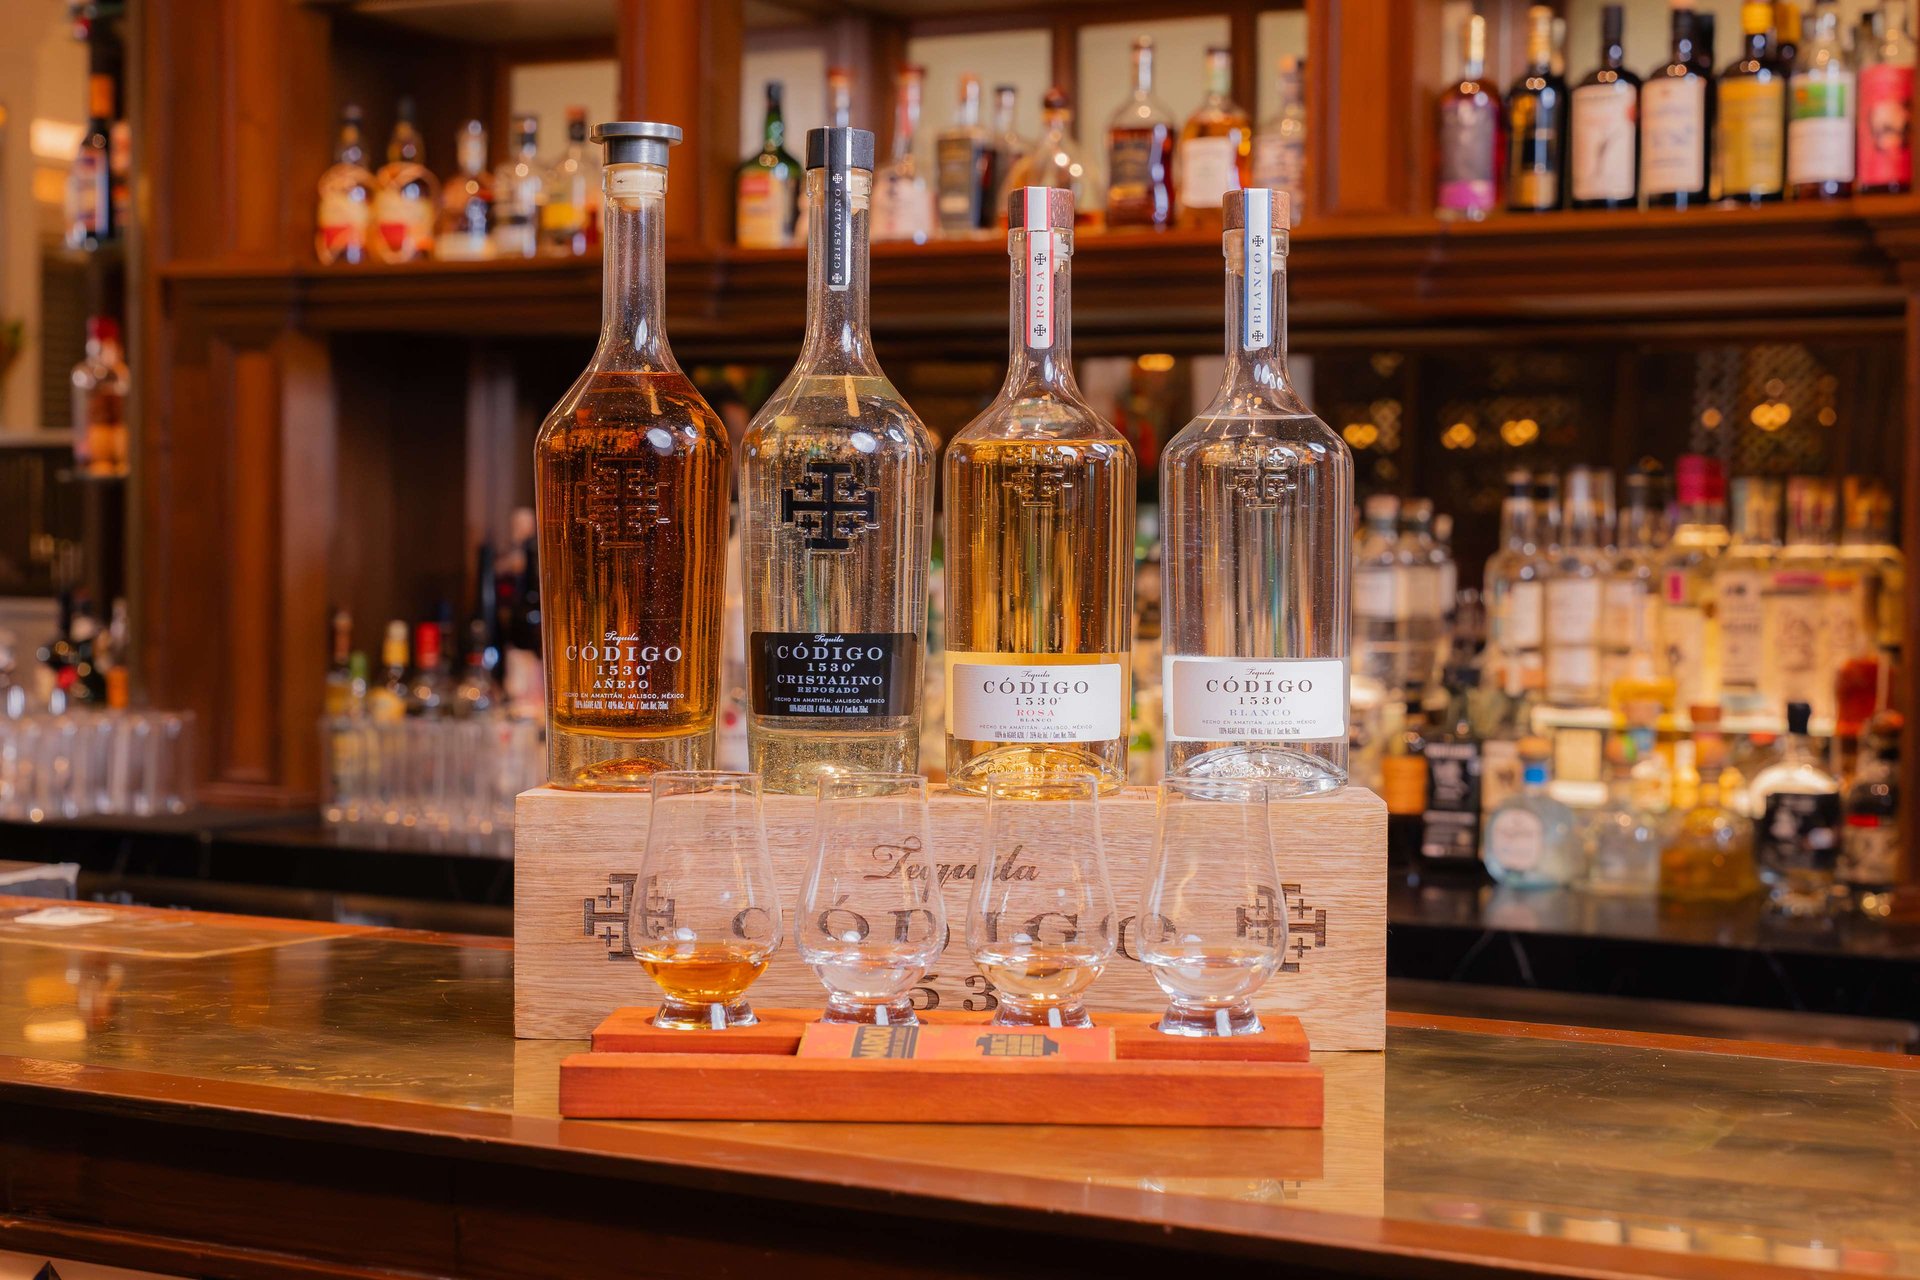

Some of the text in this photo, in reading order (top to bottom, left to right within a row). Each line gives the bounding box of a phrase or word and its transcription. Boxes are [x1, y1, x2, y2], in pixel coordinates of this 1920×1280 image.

[1036, 271, 1044, 318] ROSA
[604, 631, 639, 645] Tequila
[814, 634, 844, 646] Tequila
[566, 641, 682, 661] CÓDIGO
[777, 642, 883, 660] CÓDIGO
[777, 675, 882, 685] CRISTALINO
[1020, 670, 1050, 681] Tequila
[1246, 668, 1274, 679] Tequila
[593, 679, 648, 689] AÑEJO
[983, 677, 1089, 694] CÓDIGO
[1206, 676, 1312, 693] CÓDIGO
[863, 836, 1040, 903] Tequila
